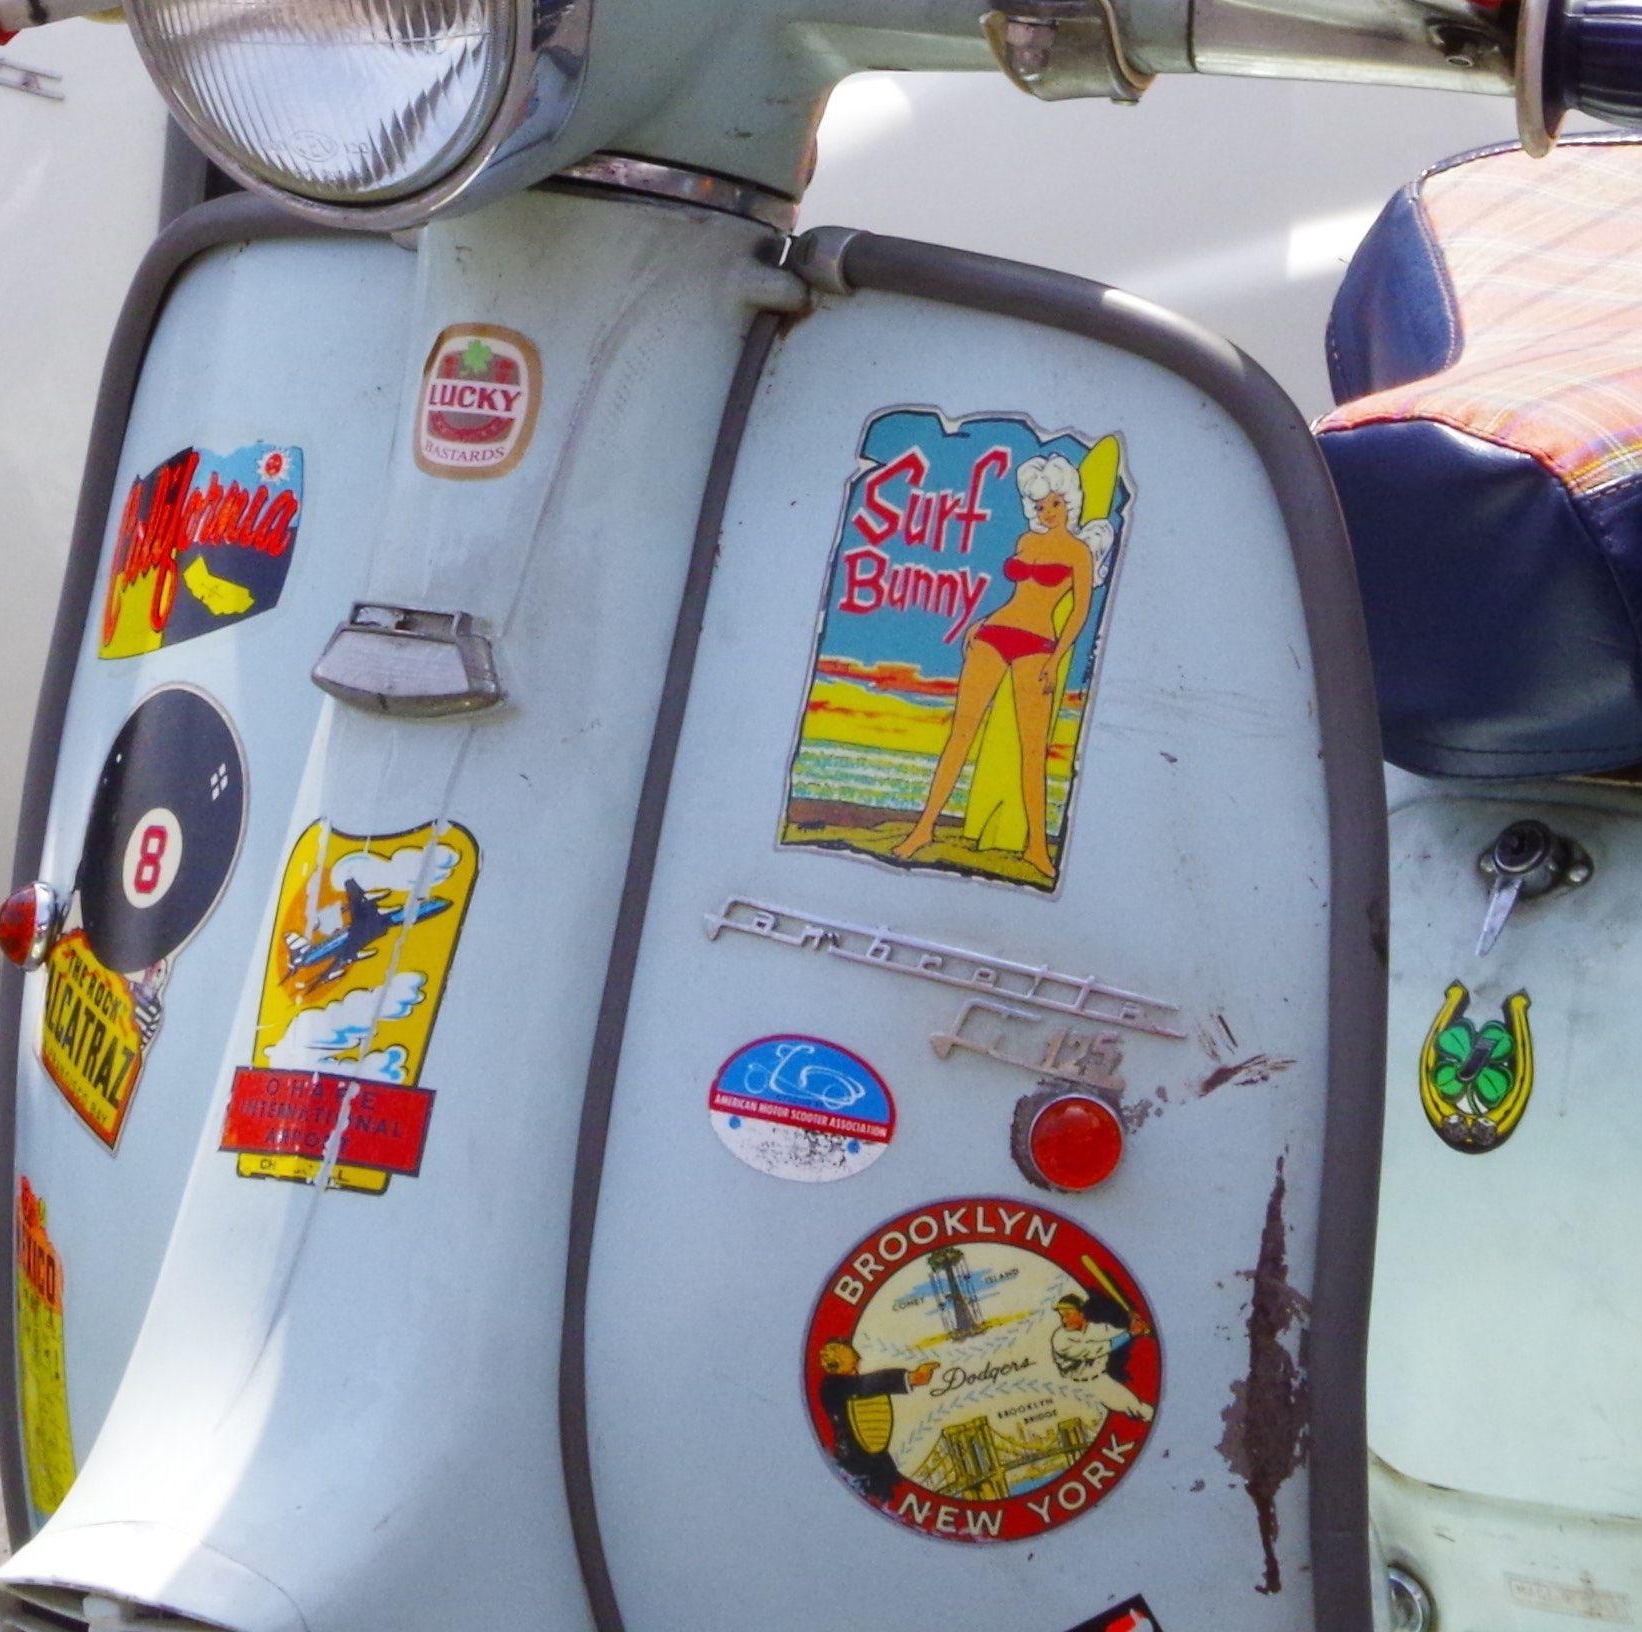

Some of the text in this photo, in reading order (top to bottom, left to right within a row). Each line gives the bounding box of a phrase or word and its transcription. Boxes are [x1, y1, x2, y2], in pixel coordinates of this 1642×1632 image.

[428, 383, 522, 412] LUCKY
[424, 440, 506, 462] BASTARDS
[851, 445, 1012, 554] Surf
[103, 450, 299, 647] California
[837, 545, 991, 645] Bunny
[133, 825, 169, 894] 8
[704, 895, 1188, 1039] Lambretta
[45, 962, 136, 1109] ALCATRAZ
[1043, 1026, 1125, 1092] 125
[239, 1098, 401, 1138] INTERNATINAL
[714, 1094, 757, 1112] AMERICAN
[758, 1102, 790, 1118] MOTOR
[790, 1109, 828, 1126] SCOOTER
[828, 1115, 888, 1137] ASSOCIATION
[833, 1206, 1058, 1306] BROOKLYN
[929, 1357, 1037, 1397] Dodgers
[997, 1398, 1054, 1419] BROOKLYN
[897, 1432, 1136, 1538] NEW YORK
